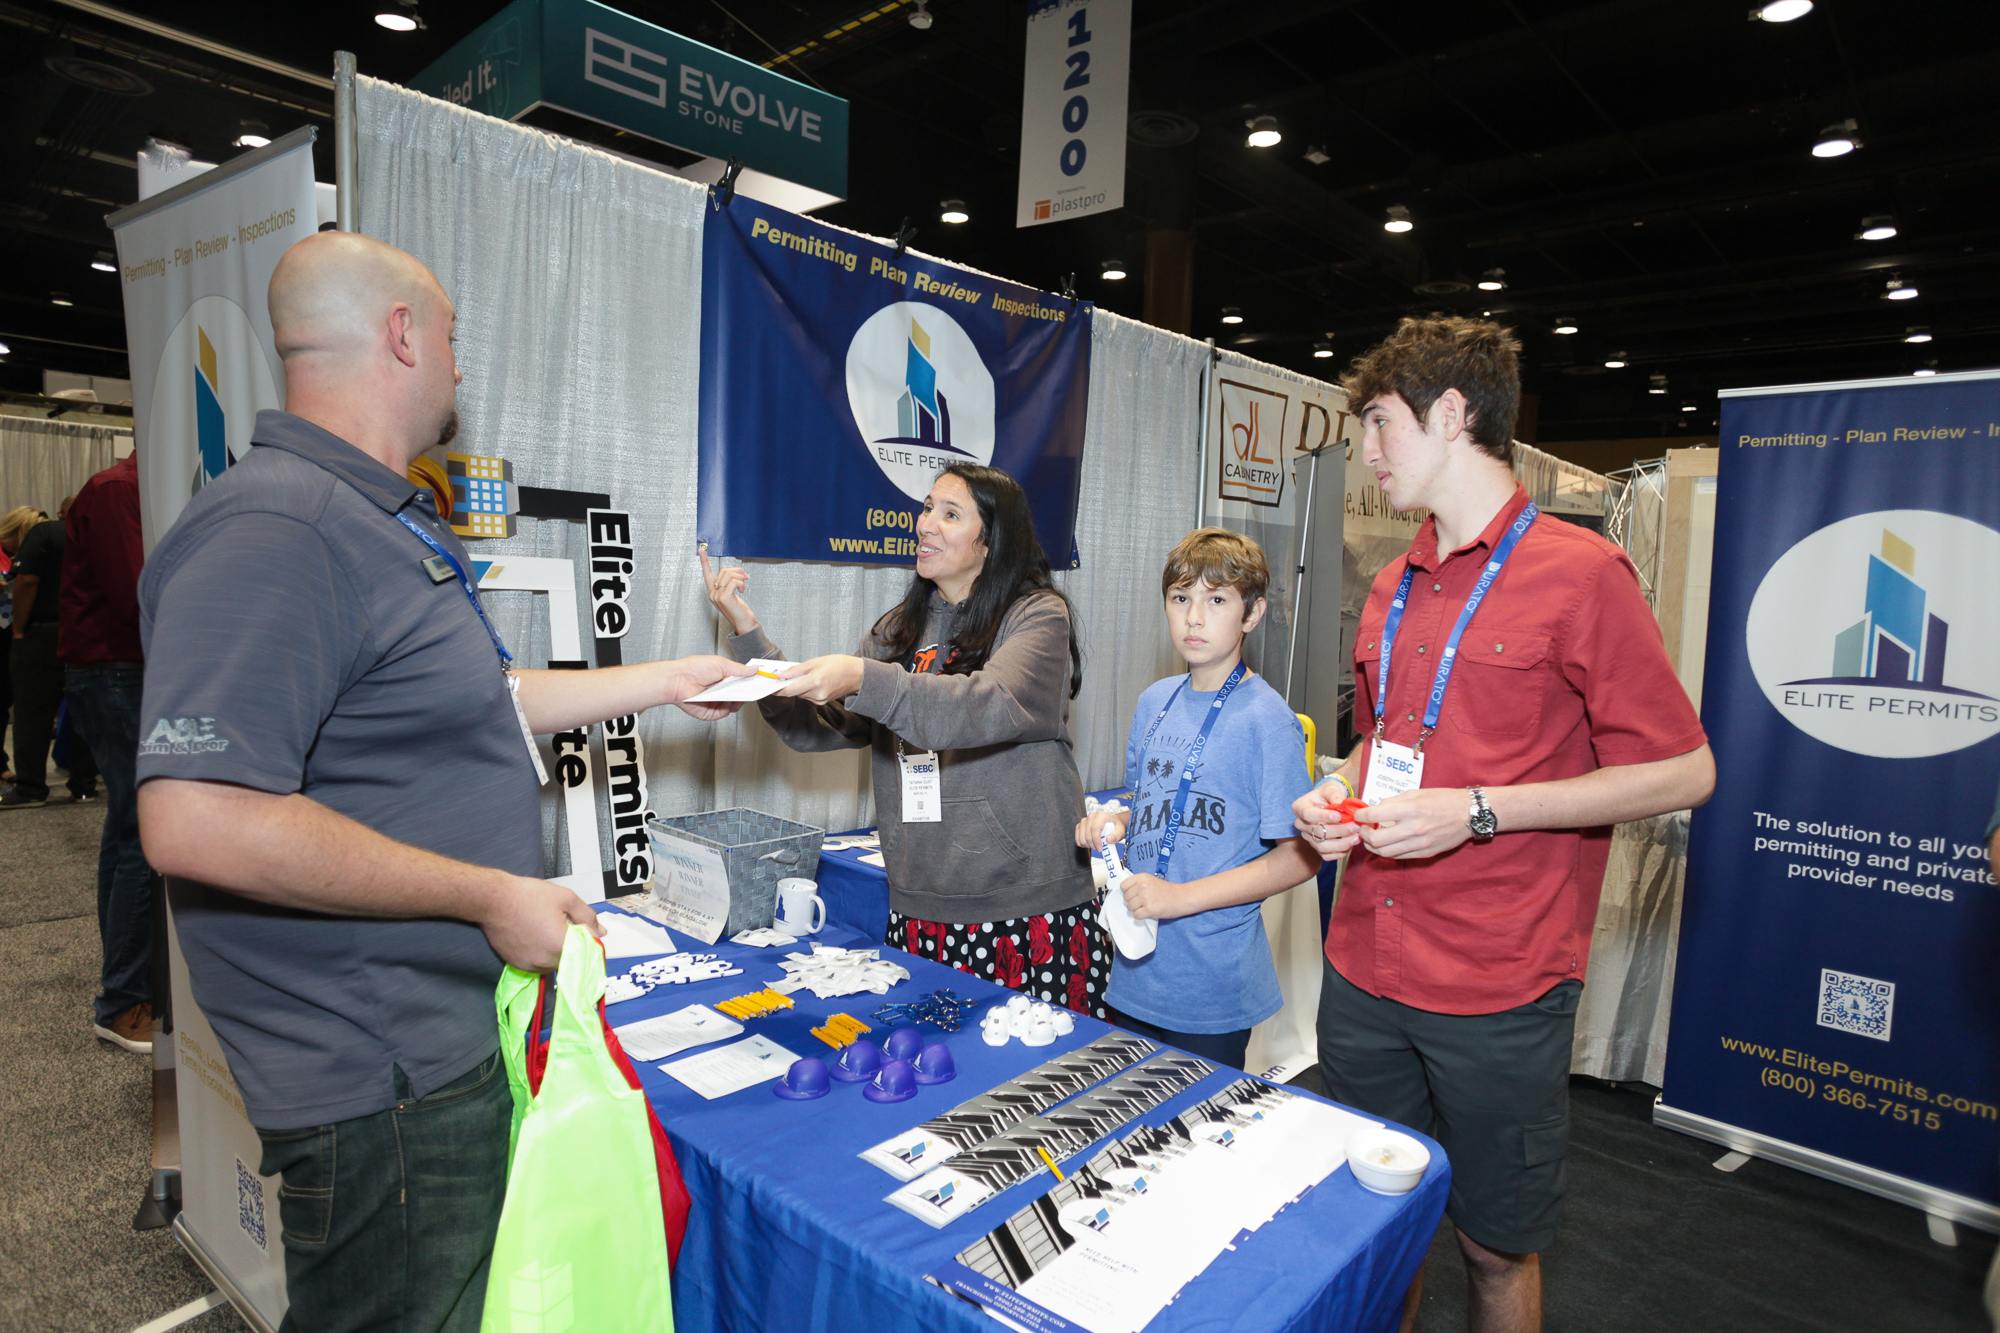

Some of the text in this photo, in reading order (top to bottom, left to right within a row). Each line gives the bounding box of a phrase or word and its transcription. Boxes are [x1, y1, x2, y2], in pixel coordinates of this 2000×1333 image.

[443, 60, 497, 105] iled It.
[1060, 8, 1092, 176] 1200
[678, 101, 743, 135] STONE
[679, 64, 822, 142] EVOLVE
[1052, 192, 1105, 216] plastpro
[125, 258, 166, 284] Permitting
[174, 248, 193, 267] Plan
[195, 235, 229, 260] Review
[238, 208, 296, 244] Inspections
[751, 217, 1066, 322] Permitting Plan Review Inspections
[1738, 432, 1827, 448] Permitting
[1846, 428, 1887, 444] Plan
[1893, 425, 1966, 442] Review
[1989, 423, 2000, 437] In
[878, 447, 913, 466] ELITE
[397, 512, 437, 546] RATO
[866, 508, 914, 533] (800)
[829, 537, 920, 556] www.Elit
[589, 511, 633, 634] Elite
[1784, 690, 1999, 722] ELITE PERMITS
[913, 764, 933, 773] SEBC
[1386, 757, 1414, 774] SEBC
[604, 712, 658, 885] ermits
[1388, 785, 1405, 793] PERMIT
[1130, 797, 1226, 838] HAMAS
[1753, 812, 1992, 861] The solution to all you
[673, 855, 704, 874] WINNER
[1753, 835, 1999, 886] permitting and private
[678, 870, 704, 888] WINNER
[1787, 861, 1955, 902] provider needs
[662, 905, 678, 915] BEACH
[679, 912, 708, 927] BUNGALOW
[677, 904, 690, 912] STAY
[691, 909, 702, 917] FOR
[1721, 1035, 1998, 1121] www.ElitePermits.com
[1760, 1067, 1941, 1130] (800) 366-7515
[1085, 1247, 1139, 1273] NEED HELP WITH
[955, 1280, 993, 1304] FRANCHISING
[993, 1300, 1040, 1329] OPPORTUNITIES
[983, 1281, 1066, 1329] WWW.ELITEPERMITS.COM
